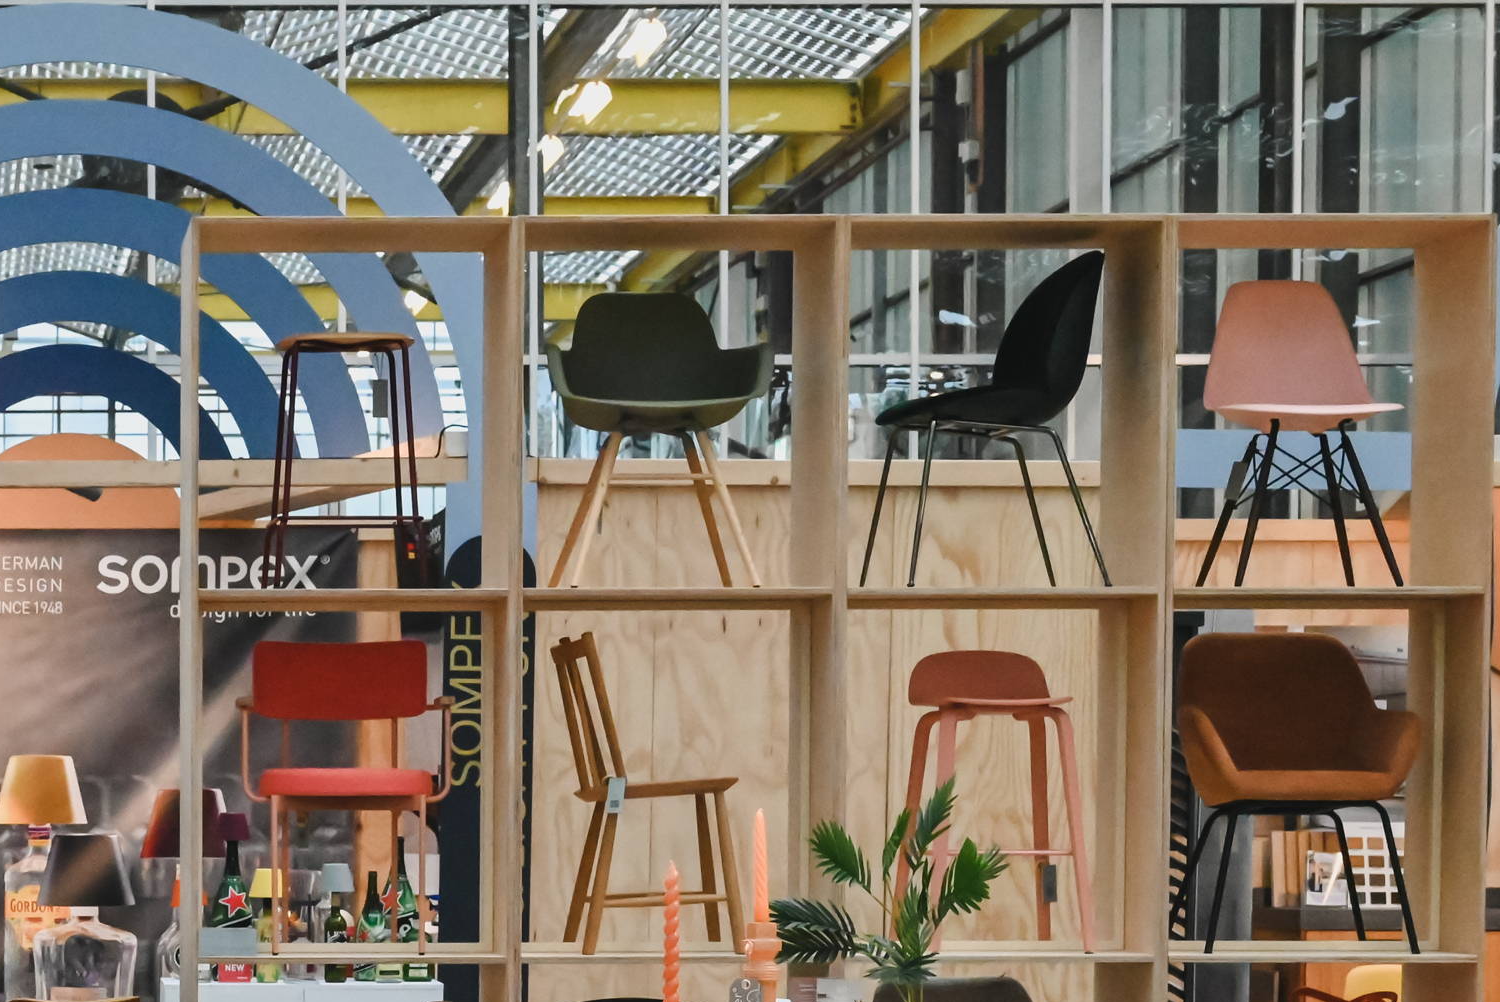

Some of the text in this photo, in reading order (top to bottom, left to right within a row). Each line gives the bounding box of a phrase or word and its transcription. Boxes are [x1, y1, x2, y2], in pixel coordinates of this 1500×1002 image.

[34, 600, 63, 615] 1948
[449, 580, 482, 789] SOMPE
[225, 963, 246, 972] NEW
